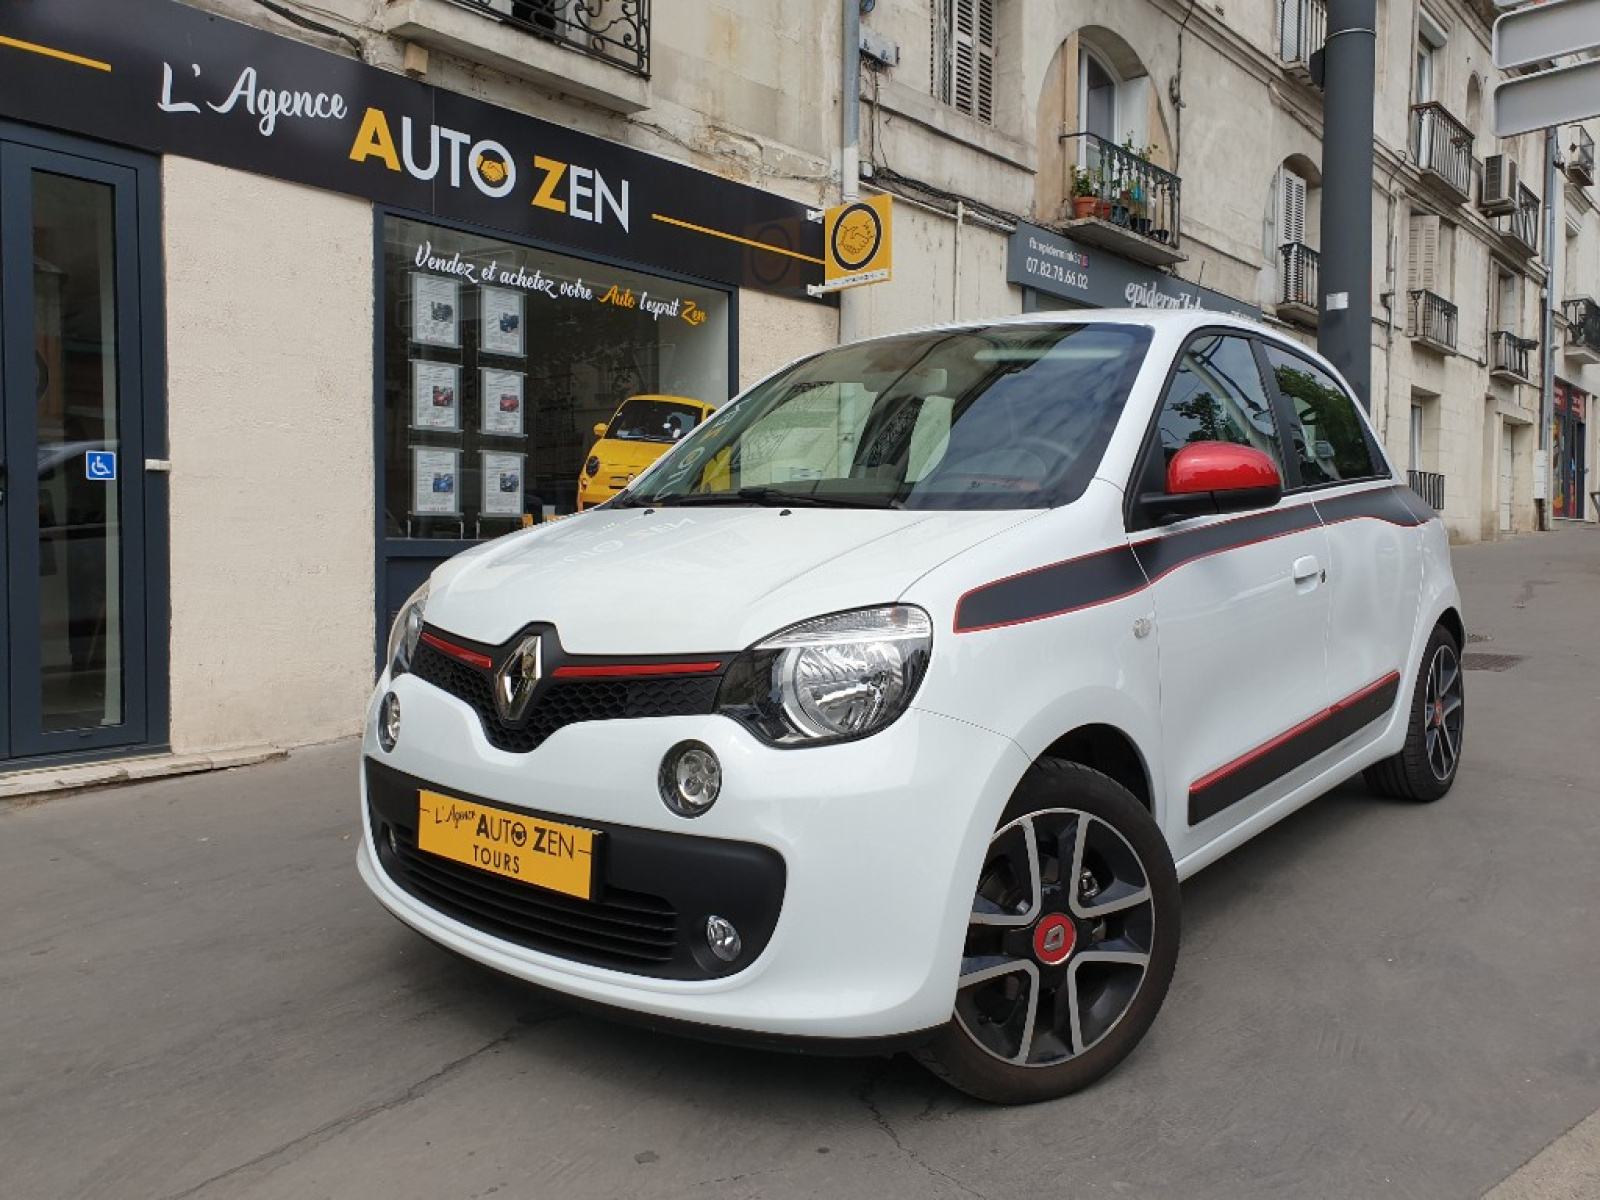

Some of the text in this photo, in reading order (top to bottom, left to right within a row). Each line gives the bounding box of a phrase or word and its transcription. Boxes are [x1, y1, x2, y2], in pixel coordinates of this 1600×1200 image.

[157, 62, 629, 234] L'Agence AUTO ZEN
[415, 240, 479, 284] Vendez
[481, 260, 498, 281] et
[499, 267, 558, 299] achetez
[559, 278, 593, 301] votre
[596, 285, 636, 309] Auto
[680, 301, 707, 326] Zen
[1026, 256, 1089, 290] 07.82.78.66.02
[472, 844, 521, 875] TOURS
[476, 813, 528, 848] AUTO
[532, 826, 575, 861] ZEN
